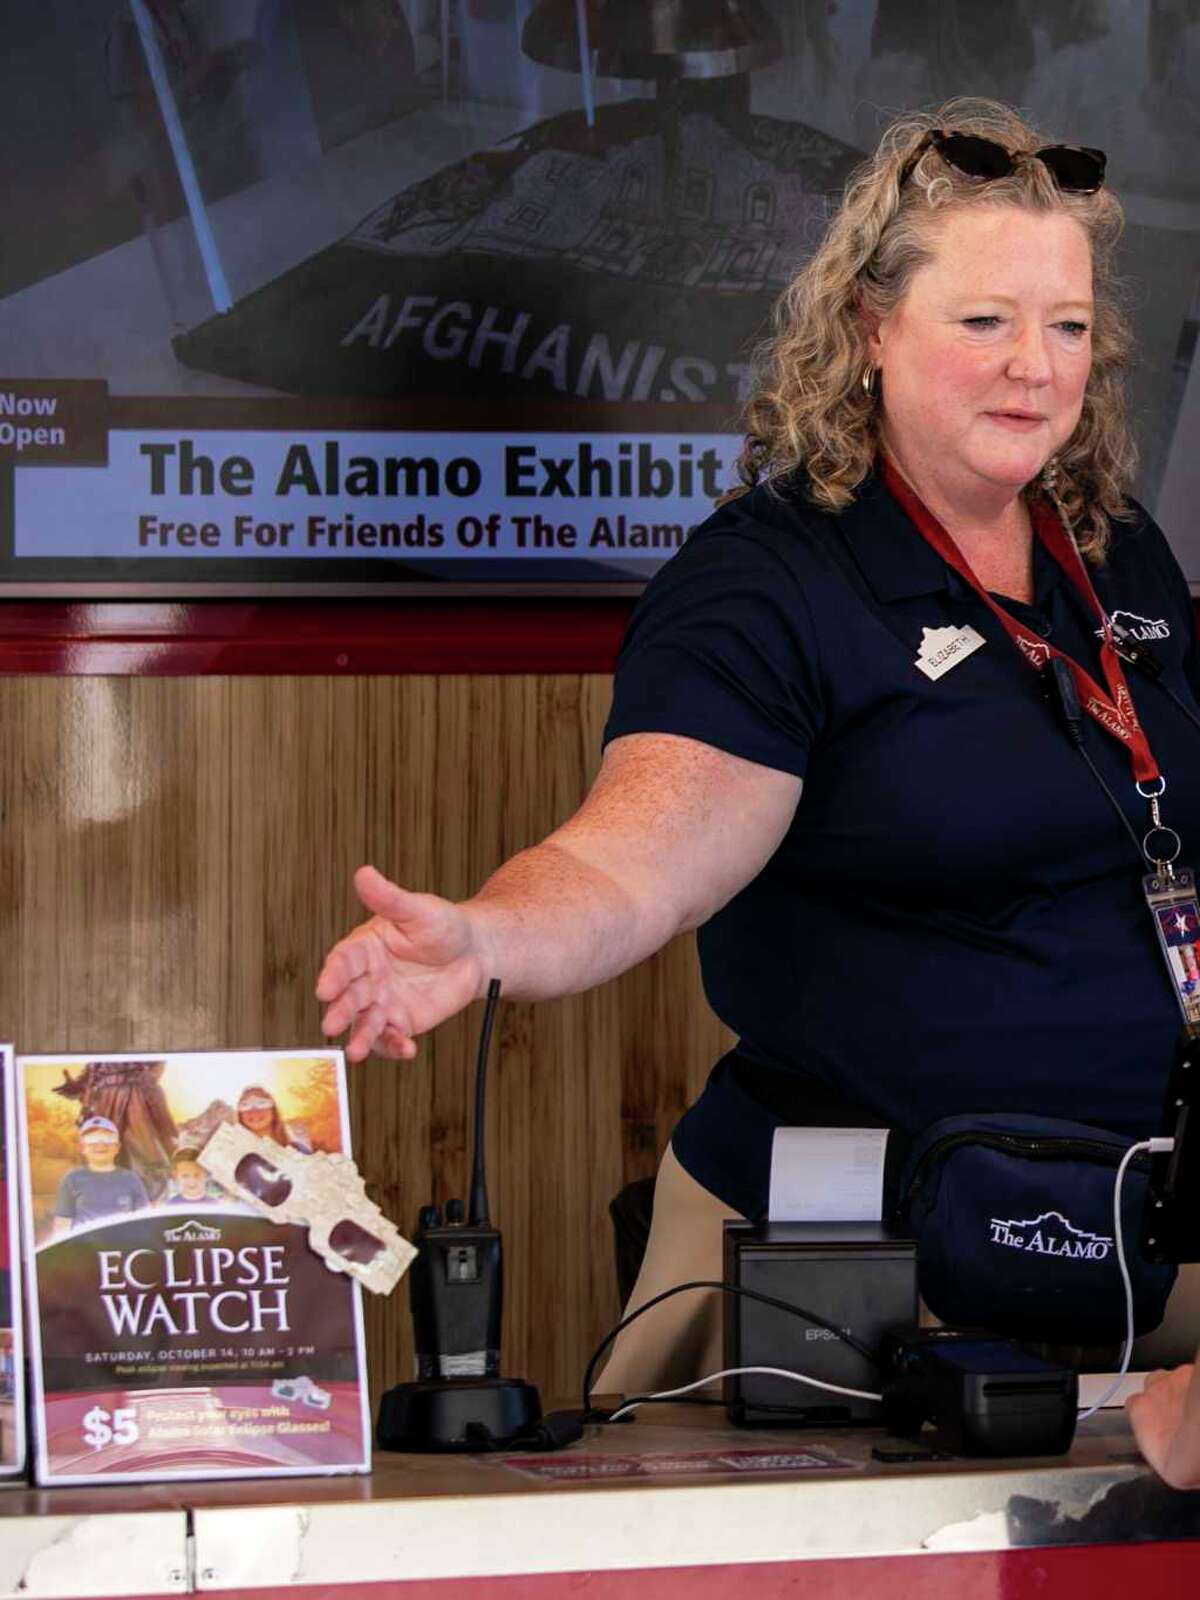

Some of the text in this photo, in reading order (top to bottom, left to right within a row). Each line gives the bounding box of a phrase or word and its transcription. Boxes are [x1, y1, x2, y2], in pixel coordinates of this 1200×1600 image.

[0, 392, 57, 416] Now
[0, 422, 66, 451] Open
[140, 440, 725, 498] The Alamo Exhibit
[139, 516, 221, 547] Free
[235, 516, 295, 547] For
[307, 513, 446, 548] Friends
[457, 514, 502, 548] Of
[510, 514, 578, 548] The
[927, 634, 969, 668] ELIZABETH
[990, 1223, 1109, 1260] The ALAMO
[97, 1246, 291, 1290] ECLIPSE
[101, 1289, 291, 1336] WATCH
[159, 1347, 217, 1361] OCTOBER
[83, 1405, 140, 1450] $5
